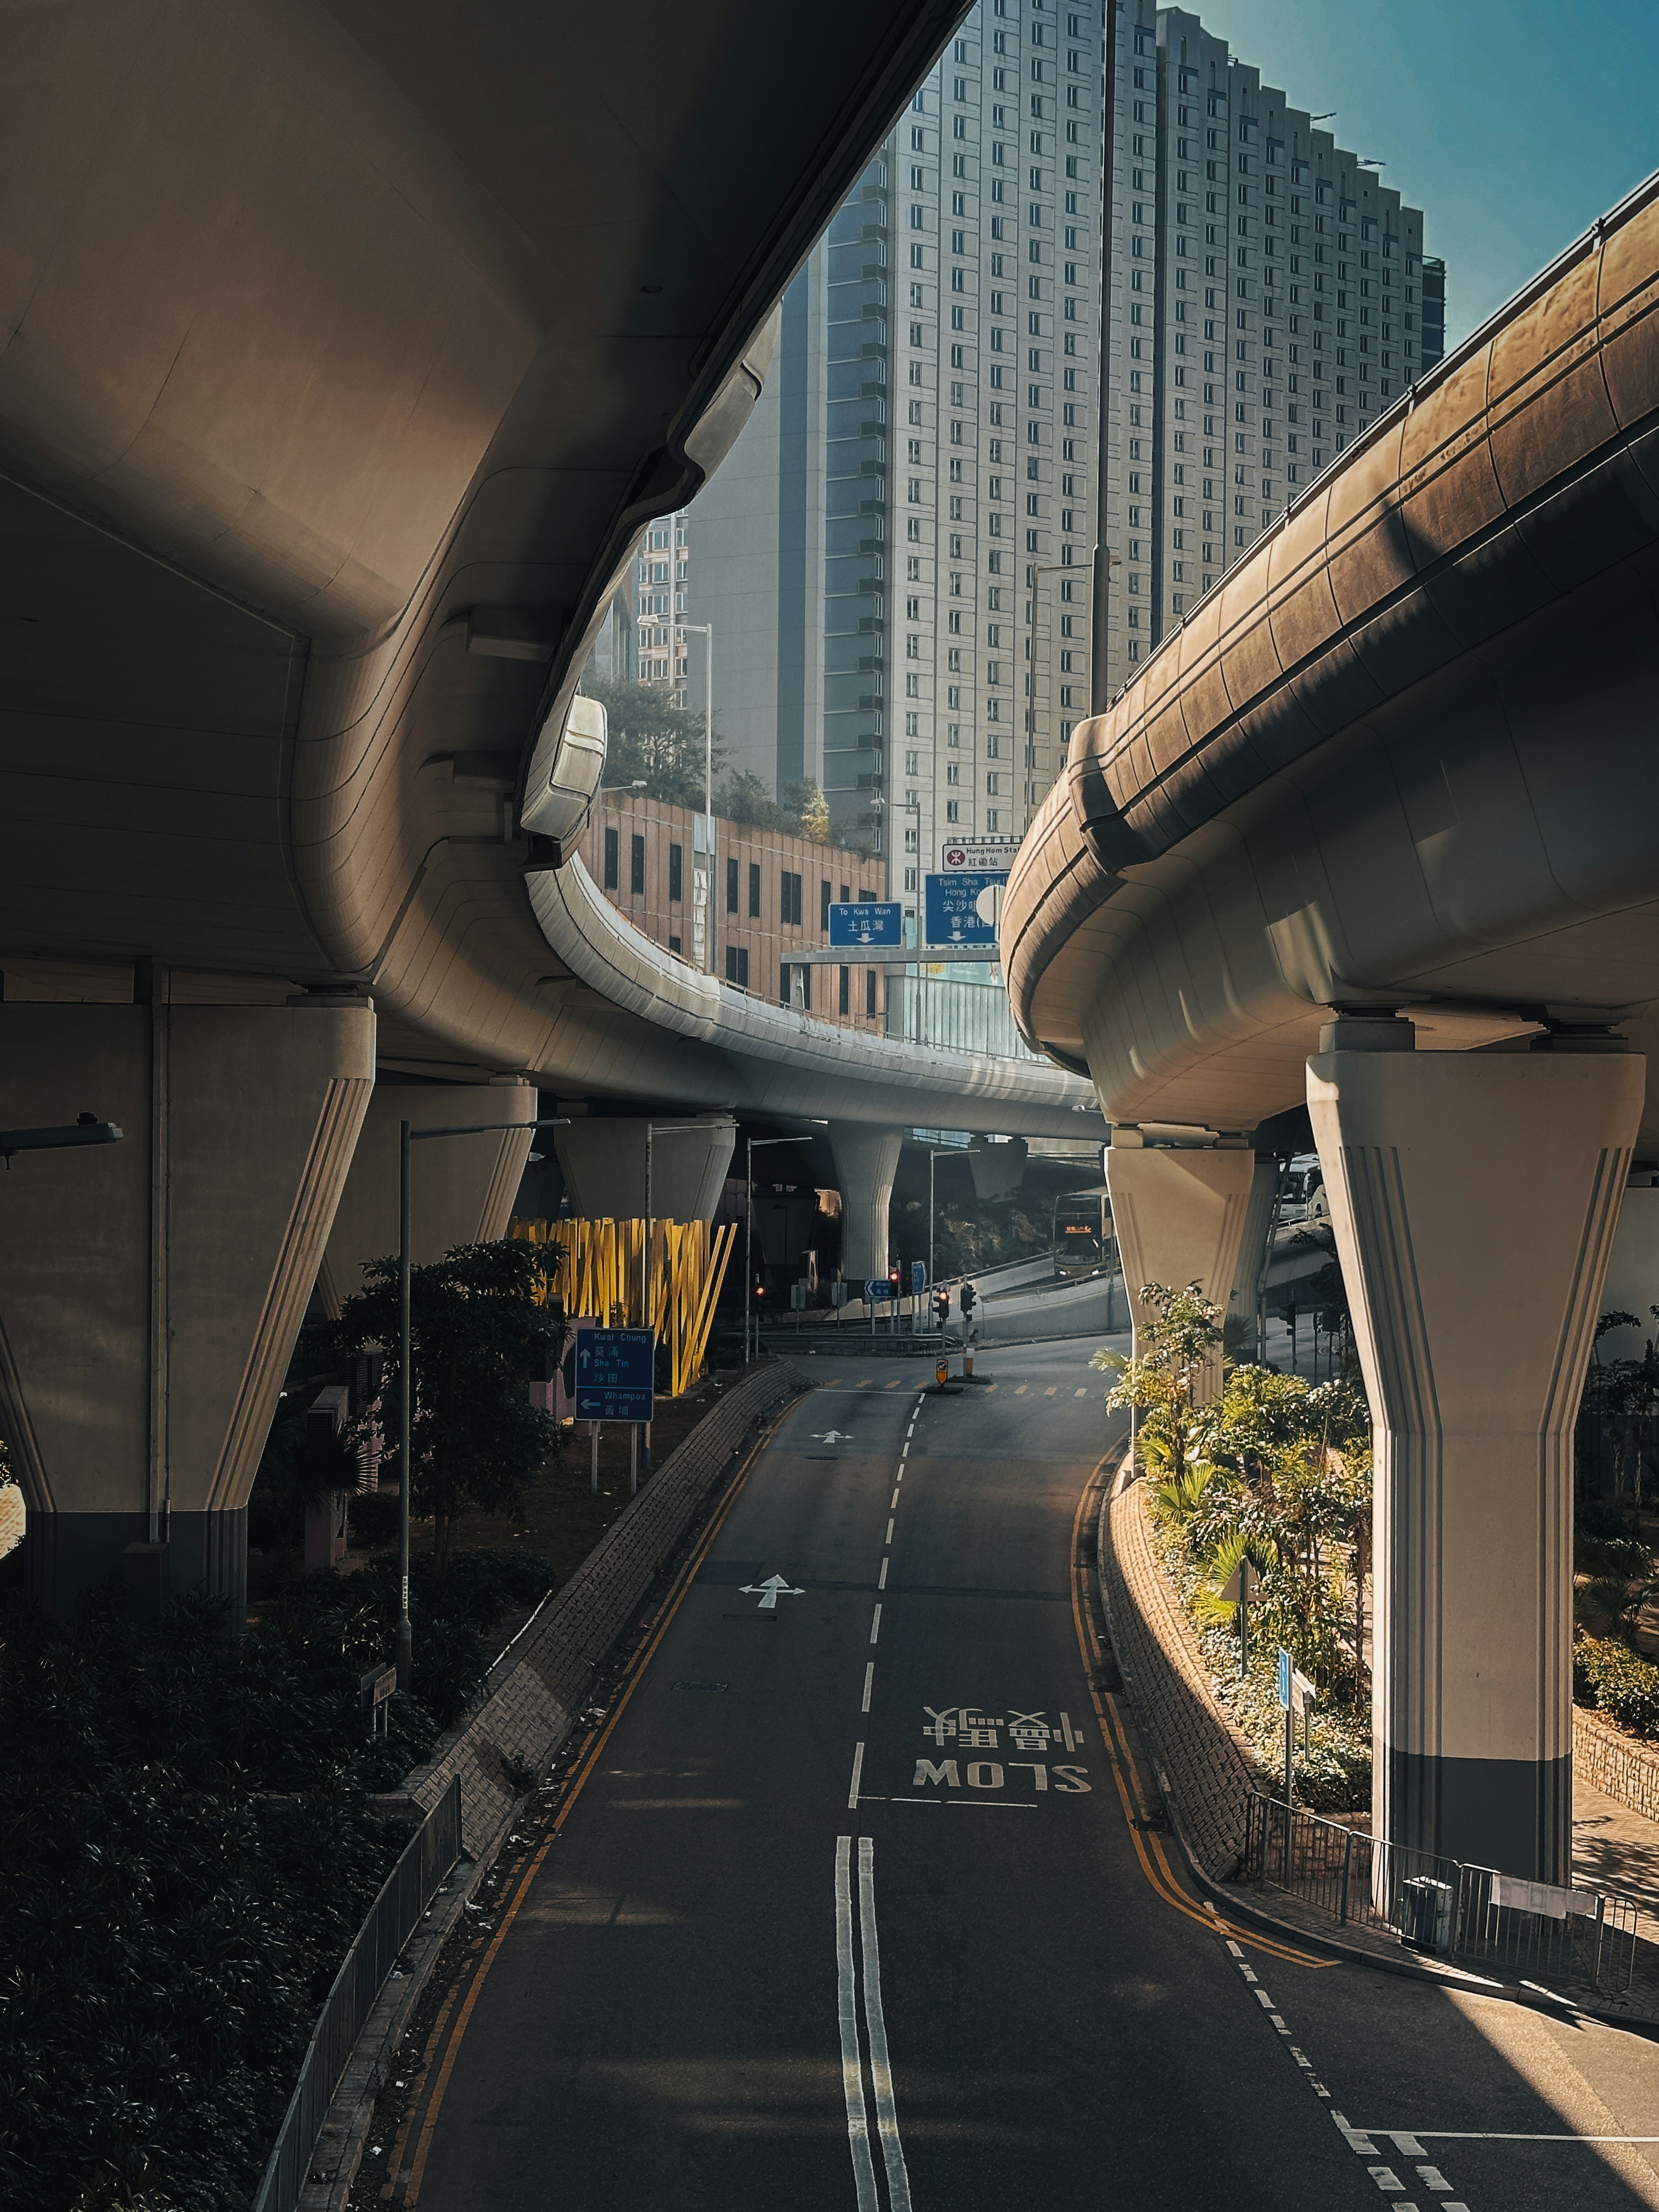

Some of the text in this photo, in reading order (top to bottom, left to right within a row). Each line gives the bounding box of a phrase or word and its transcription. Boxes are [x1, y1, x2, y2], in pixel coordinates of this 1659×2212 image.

[968, 857, 998, 866] 紅磡站
[945, 889, 967, 898] Hong
[874, 907, 890, 915] Wan
[848, 920, 883, 932] 土瓜灣
[594, 1333, 646, 1344] Kwai Chung
[594, 1372, 617, 1383] 沙田
[605, 1391, 646, 1402] Whampoa
[923, 1707, 1085, 1752] 慢駛
[913, 1759, 1092, 1792] SLOW
